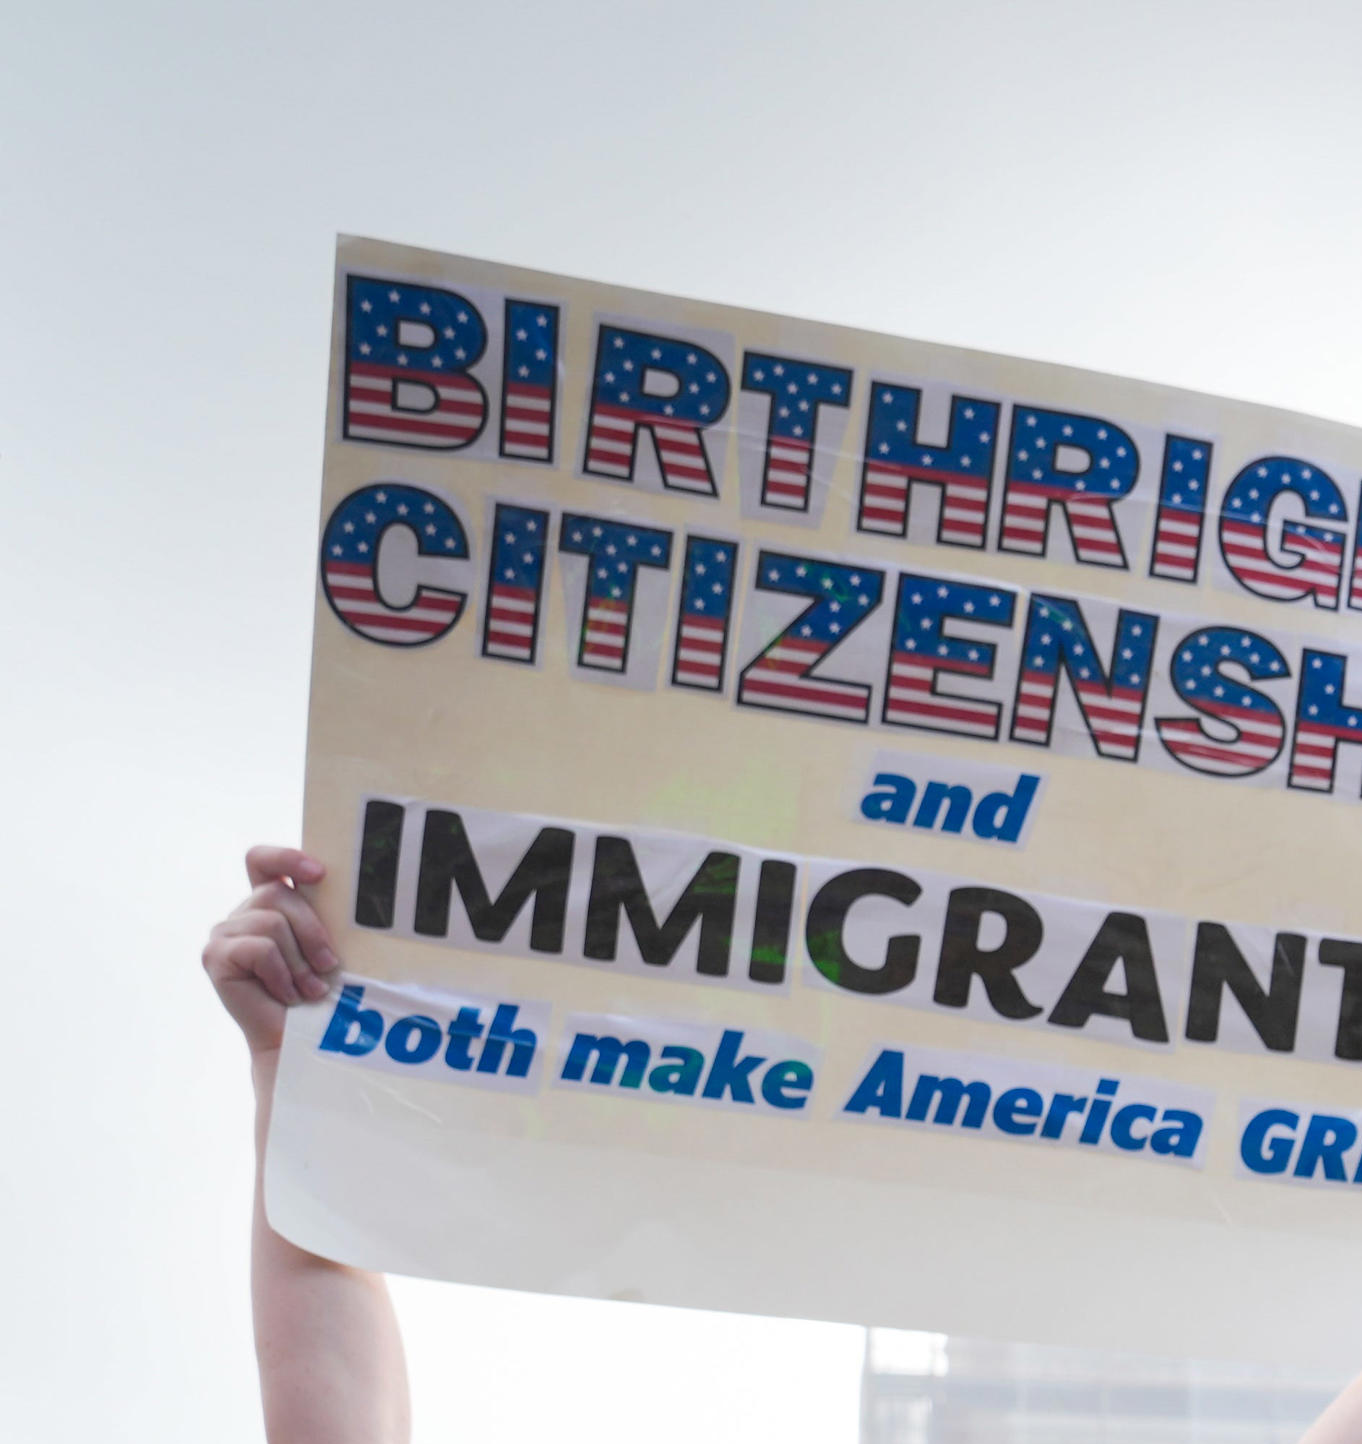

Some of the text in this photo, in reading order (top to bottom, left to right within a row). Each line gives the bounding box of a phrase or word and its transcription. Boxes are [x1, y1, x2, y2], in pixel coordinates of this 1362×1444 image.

[860, 772, 1041, 844] and
[318, 984, 537, 1078] both
[561, 1031, 814, 1111] make
[843, 1050, 1204, 1159] America
